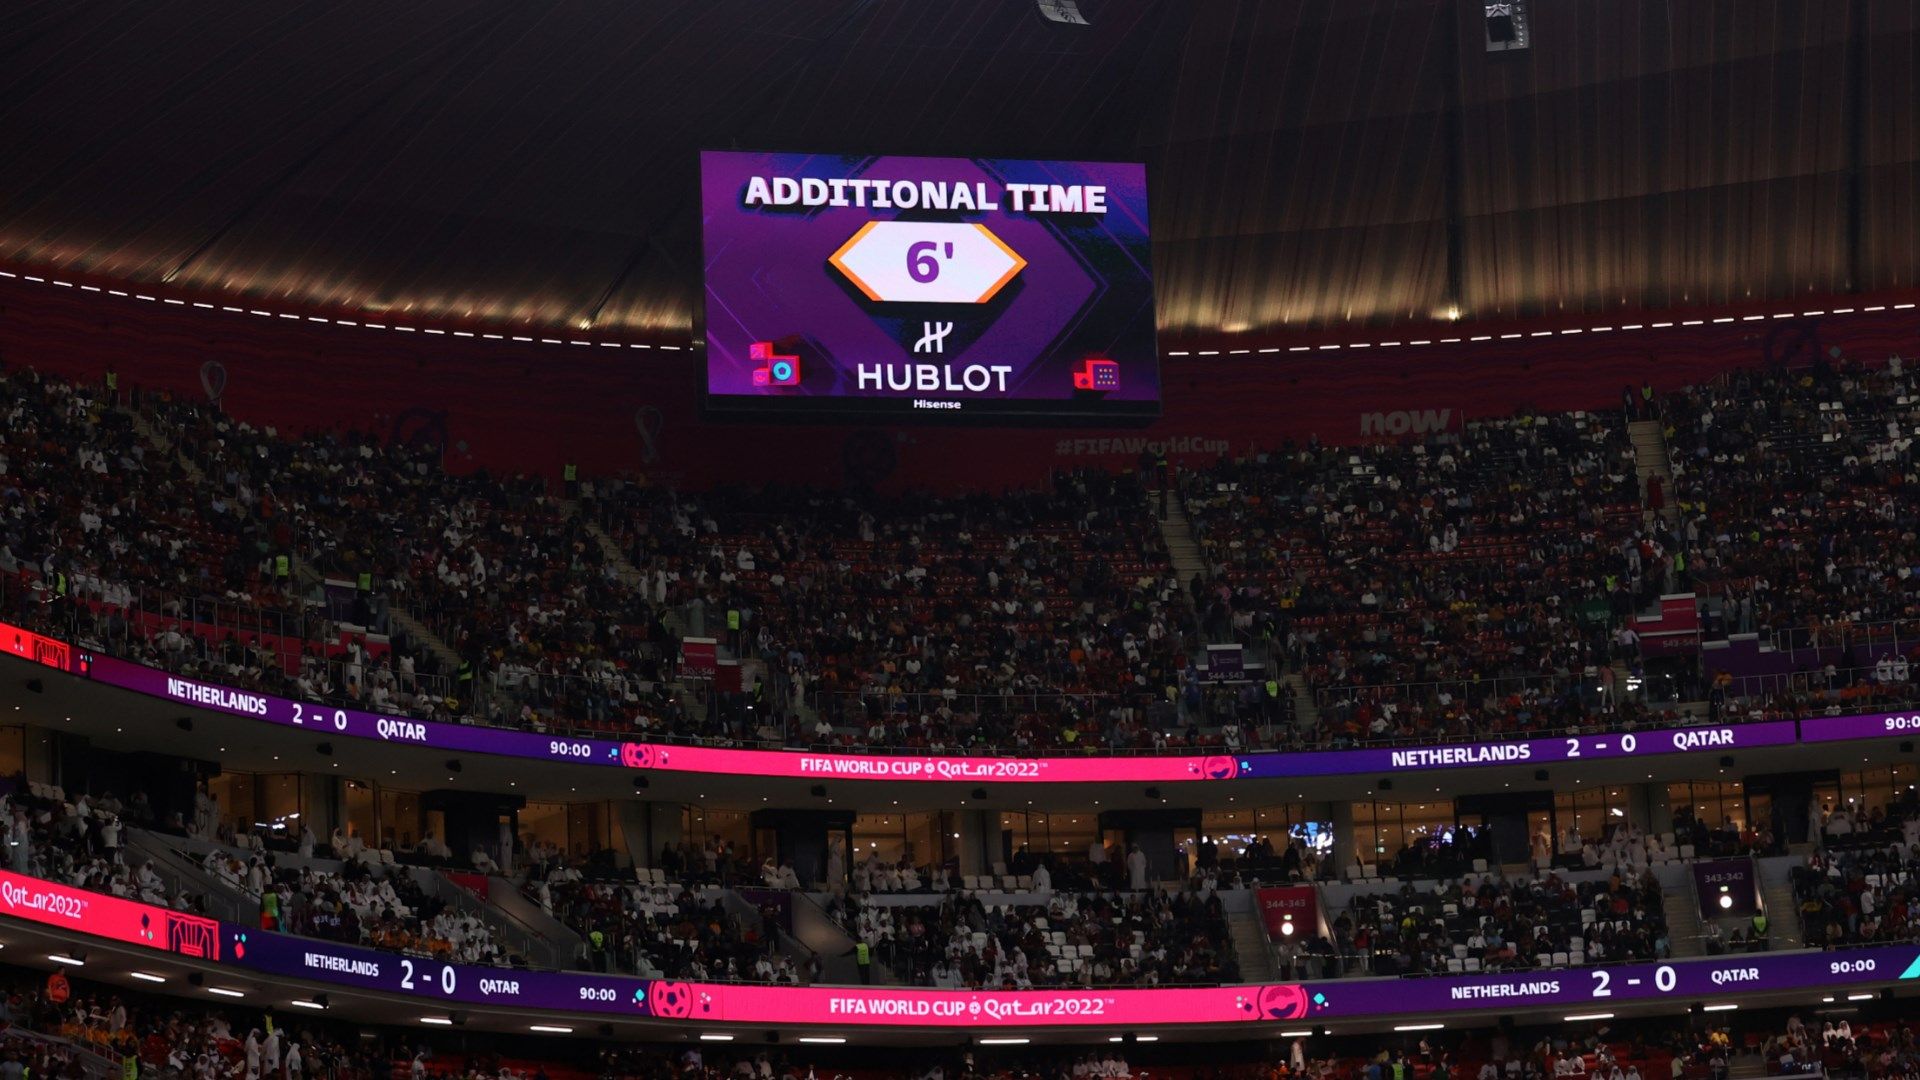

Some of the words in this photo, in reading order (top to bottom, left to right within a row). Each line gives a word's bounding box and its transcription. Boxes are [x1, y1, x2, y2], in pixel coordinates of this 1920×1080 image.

[745, 176, 999, 211] ADDITIONAL
[1005, 184, 1108, 213] TIME
[906, 240, 953, 284] 6'
[857, 363, 1012, 392] HUBLOT
[913, 399, 962, 410] Hisense
[1360, 408, 1452, 436] now
[1055, 436, 1230, 457] #FIFAWorldCup
[167, 677, 267, 715] NETHERLANDS
[292, 703, 303, 724] 2
[334, 710, 348, 731] 0
[376, 718, 427, 741] QATAR
[550, 741, 591, 758] 90:00
[1885, 715, 1920, 730] 90:0
[1391, 743, 1531, 767] NETHERLANDS
[1566, 738, 1581, 757] 2
[1620, 734, 1636, 753] 0
[1673, 729, 1734, 751] QATAR
[800, 757, 833, 773] FIFA
[834, 759, 889, 775] WORLD
[891, 761, 922, 775] CUP
[304, 952, 379, 977] NETHERLANDS
[401, 959, 414, 990] 2
[441, 965, 456, 995] 0
[479, 978, 520, 995] QATAR
[579, 986, 617, 1002] 90:00
[1451, 980, 1560, 1000] NETHERLANDS
[1591, 970, 1612, 997] 2
[1655, 965, 1677, 992] 0
[1711, 967, 1760, 985] QATAR
[1830, 959, 1876, 974] 90:00
[830, 998, 867, 1014] FIFA
[868, 999, 929, 1016] WORLD
[932, 1001, 966, 1016] CUP
